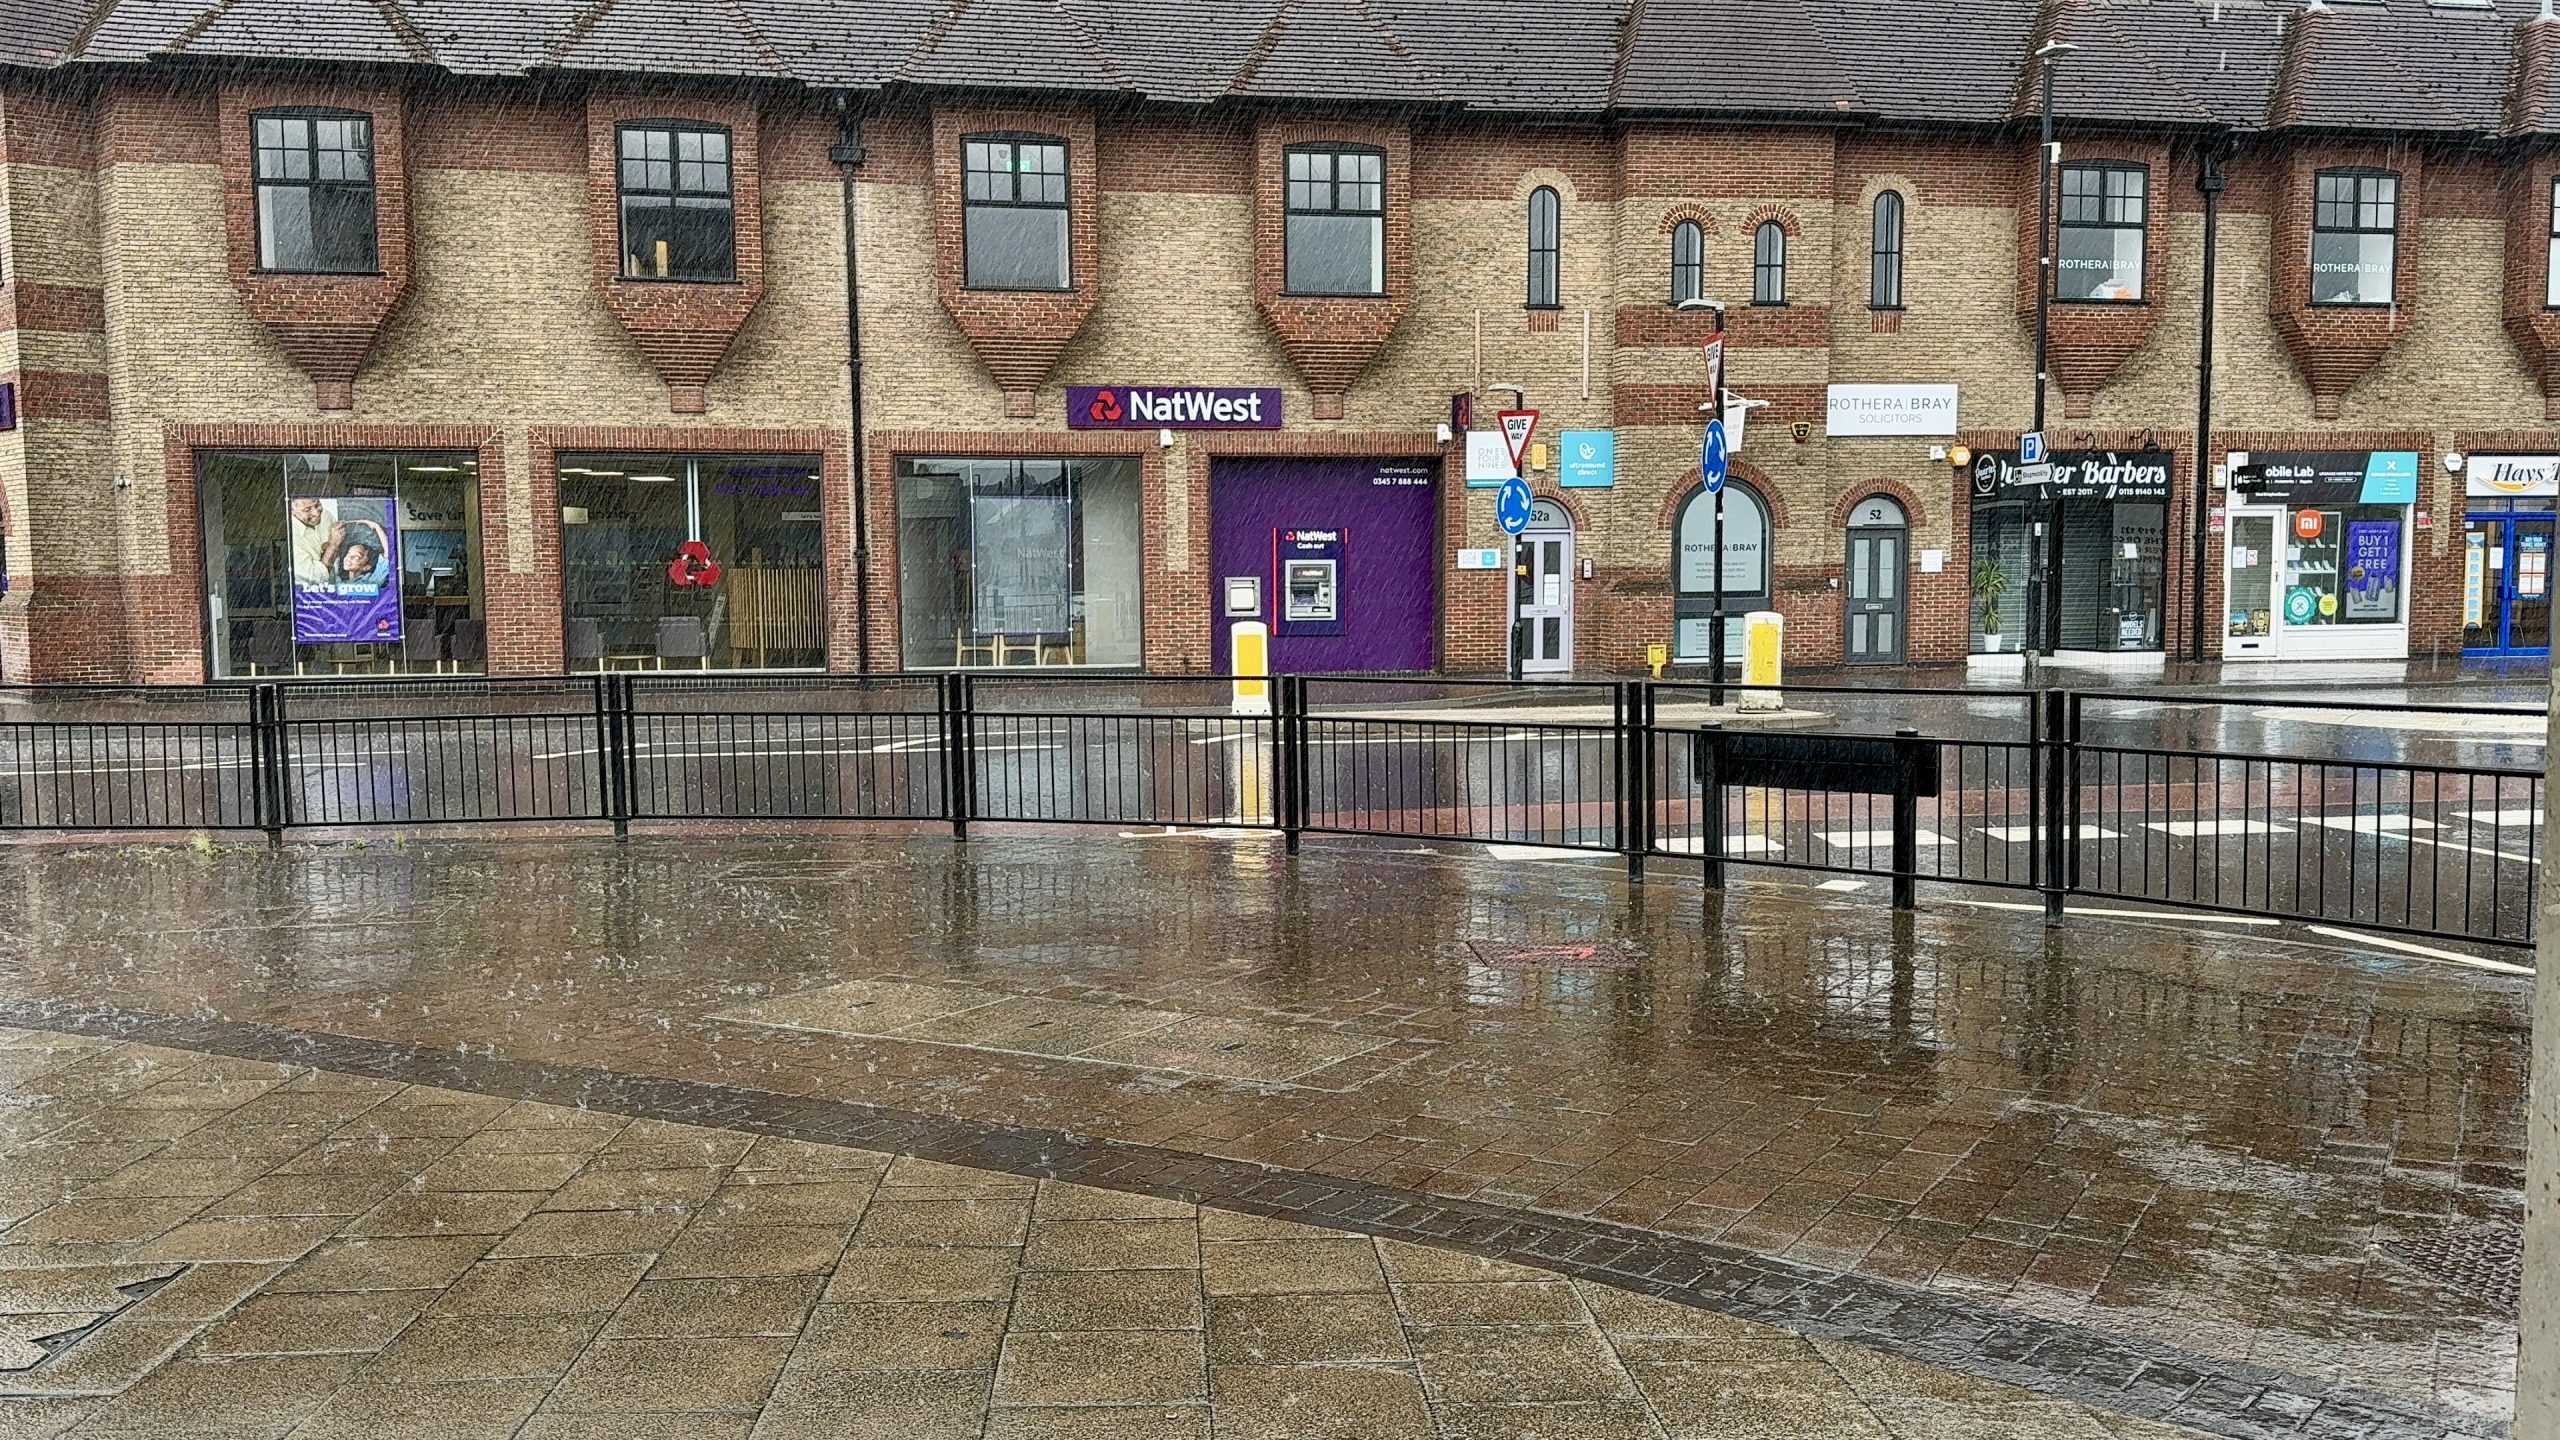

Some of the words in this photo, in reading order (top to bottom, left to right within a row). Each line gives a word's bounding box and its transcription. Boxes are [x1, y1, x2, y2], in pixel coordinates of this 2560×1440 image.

[2058, 259, 2110, 270] ROTHERA
[2112, 260, 2141, 270] BRAY
[2312, 263, 2362, 274] ROTHERA
[2364, 263, 2392, 274] BRAY
[1706, 344, 1718, 362] GIVE
[1130, 391, 1262, 422] NatWest
[1829, 398, 1902, 410] ROTHERA
[1910, 398, 1952, 410] BRAY
[1507, 419, 1527, 430] GIVE
[1858, 414, 1923, 424] SOLICITORS
[2026, 439, 2035, 458] P
[2081, 460, 2166, 484] Barbers
[2266, 466, 2292, 477] obile
[2294, 466, 2314, 477] Lab
[2492, 463, 2544, 486] Hays
[409, 509, 442, 521] Save
[1531, 510, 1550, 521] 52a
[1869, 510, 1881, 520] 52
[1296, 530, 1337, 541] NatWest
[2359, 536, 2382, 546] BUY
[2384, 536, 2388, 546] 1
[1684, 544, 1729, 552] ROTHEA
[2359, 548, 2381, 557] GET
[2384, 548, 2388, 557] 1
[2358, 559, 2387, 569] FREE
[302, 582, 336, 593] Let's
[338, 584, 376, 595] grow
